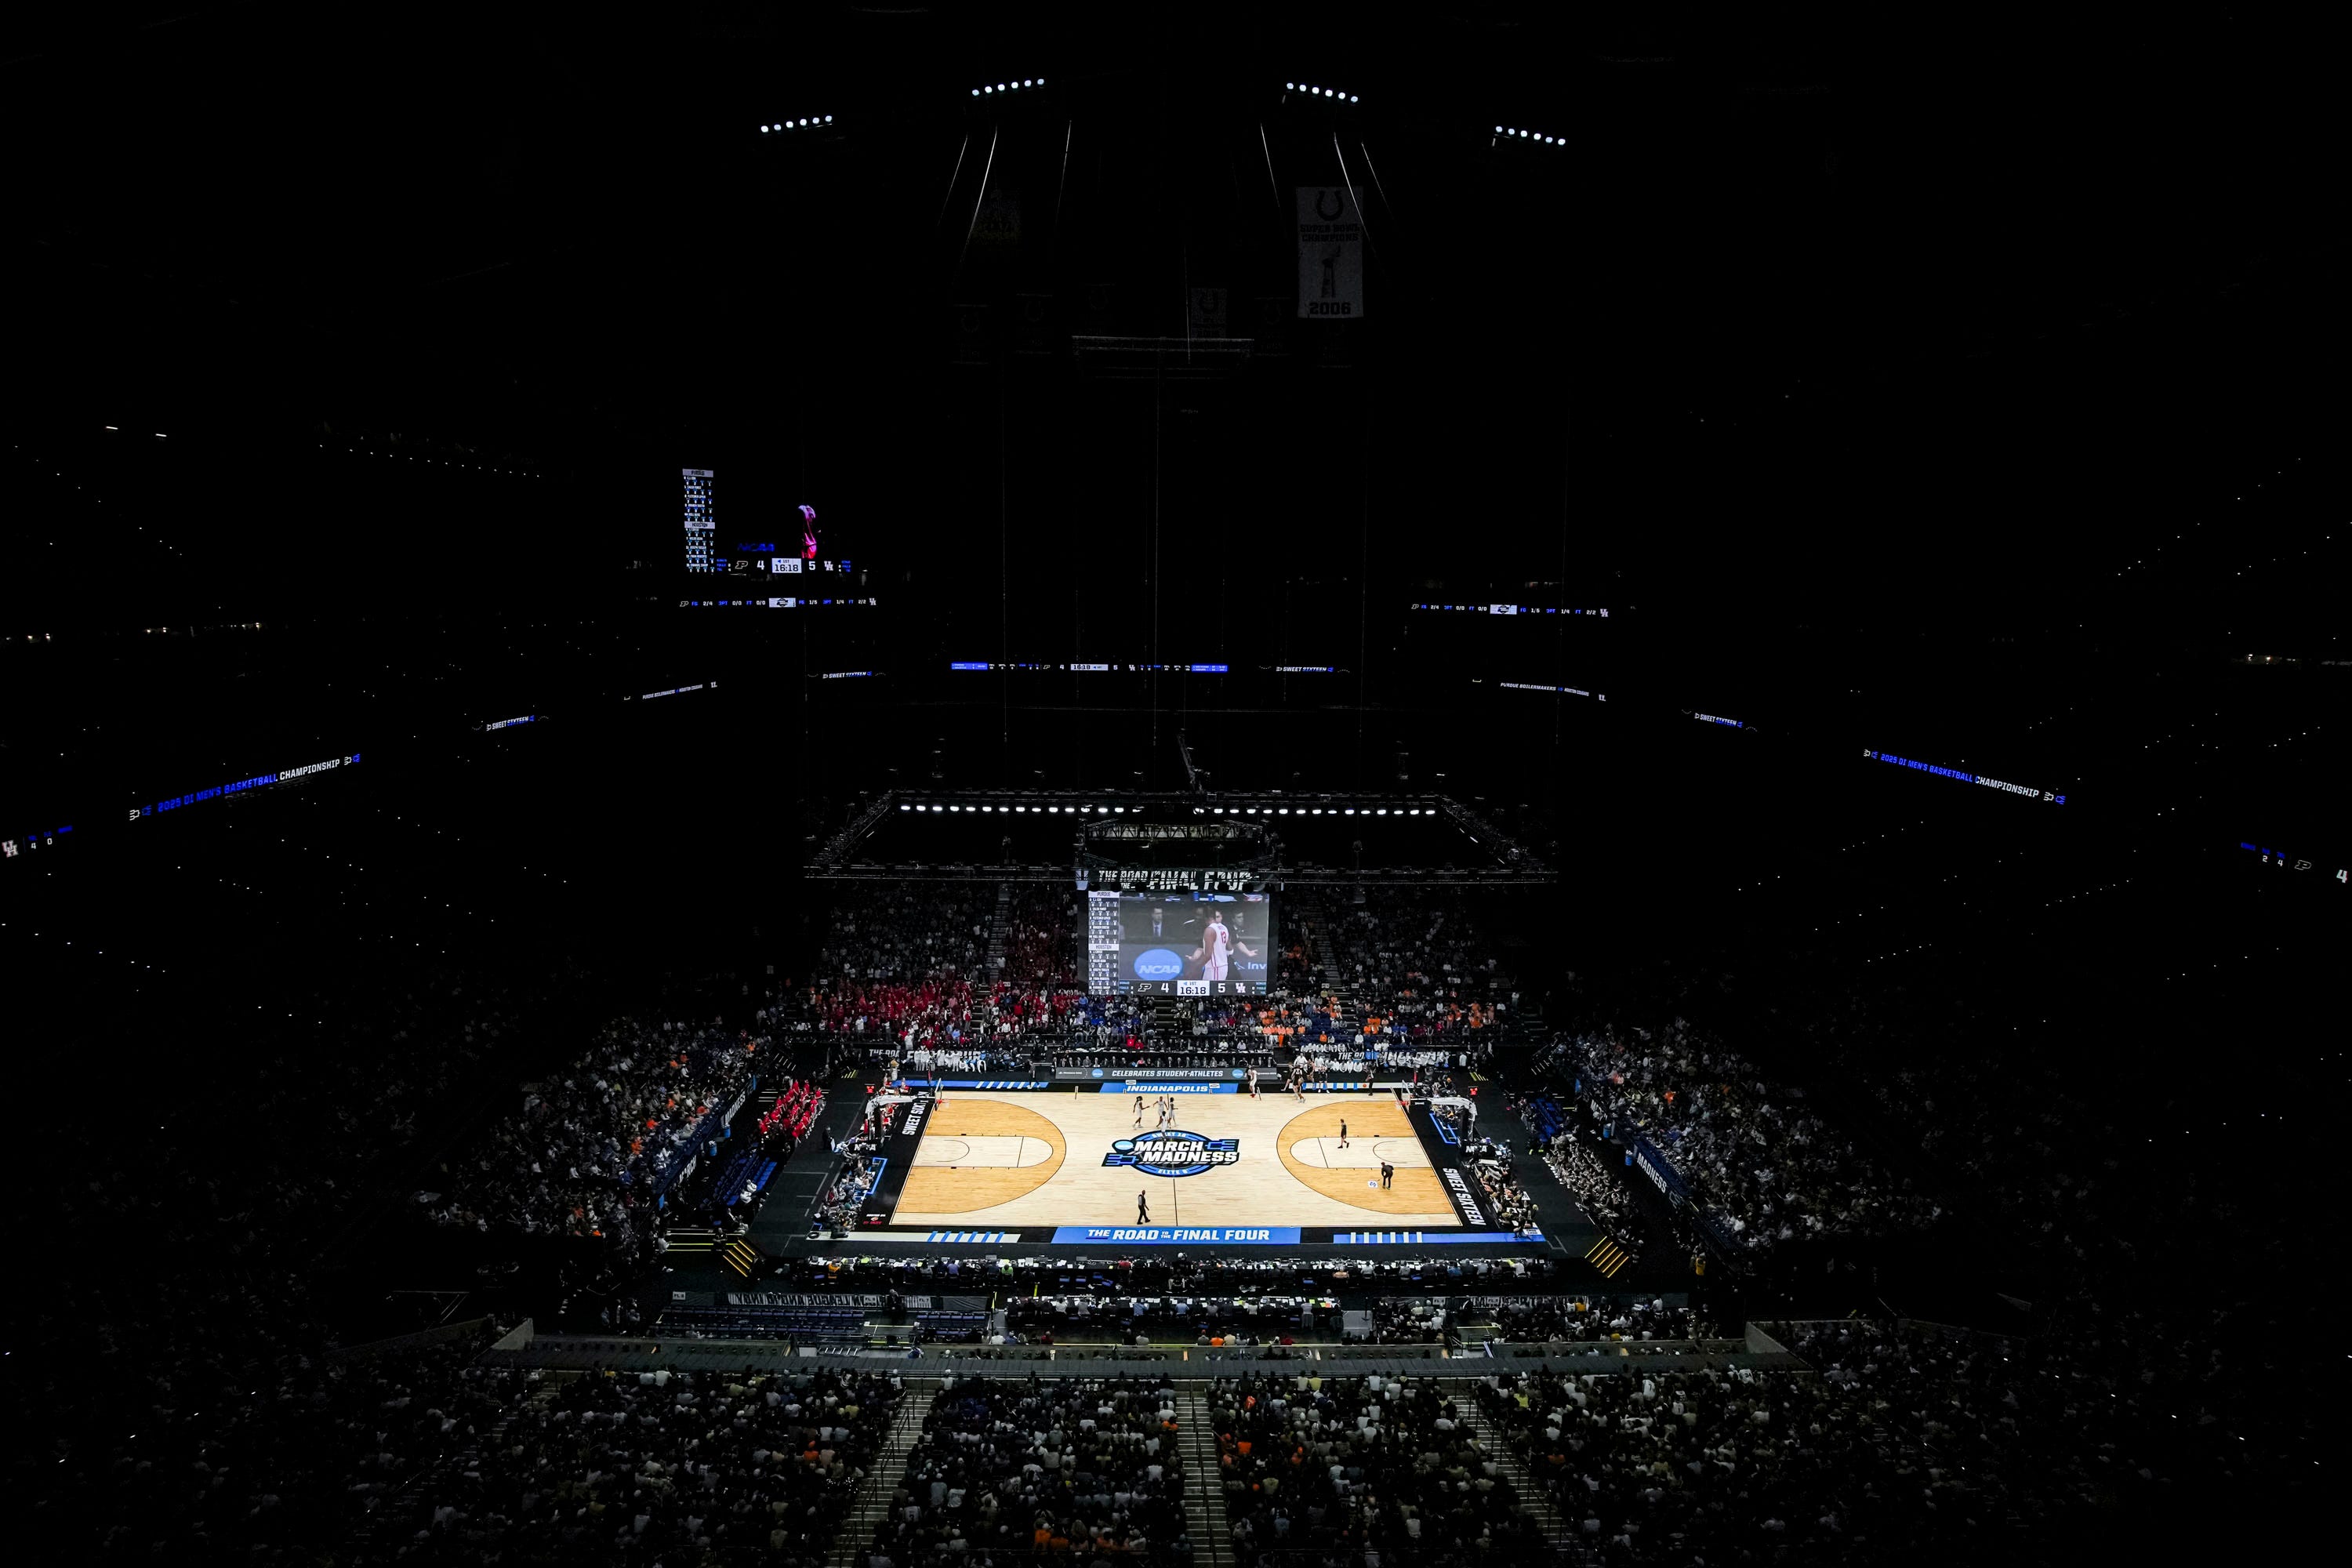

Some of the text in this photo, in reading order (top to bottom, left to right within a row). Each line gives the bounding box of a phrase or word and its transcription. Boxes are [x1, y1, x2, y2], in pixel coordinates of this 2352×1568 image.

[1301, 234, 1359, 242] CHAMPIONS
[1309, 302, 1351, 314] 2006
[757, 560, 764, 570] 4
[808, 561, 816, 571] 5
[492, 716, 529, 730] SWEET SIXTEEN
[1700, 713, 1737, 727] SWEET SIXTEEN
[1881, 753, 1897, 764] 2025
[1907, 759, 1928, 772] MEN'S
[1929, 765, 1973, 783] BASKETBALL
[1975, 775, 2039, 798] CHAMPIONSHIP
[158, 797, 181, 812] 2025
[196, 786, 221, 802] MEN'S
[224, 773, 278, 794] BASKETBALL
[280, 758, 340, 781] CHAMPIONSHIP
[1149, 871, 1199, 890] FINAL
[2336, 869, 2347, 884] 4
[1138, 965, 1181, 975] NCAA
[1160, 982, 1170, 993] 4
[1180, 986, 1207, 995] 16:18
[1218, 983, 1226, 993] 5
[1338, 1051, 1353, 1060] THE
[725, 1091, 746, 1123] MADNESS
[902, 1114, 921, 1135] SWEET
[1134, 1141, 1203, 1152] MARCH
[1142, 1151, 1237, 1162] MADNESS
[1636, 1152, 1668, 1193] MADNESS
[1443, 1167, 1486, 1225] SWEET SIXTEEN
[1112, 1229, 1160, 1240] ROAD
[1172, 1229, 1220, 1240] FINAL
[1225, 1229, 1270, 1240] FOUR
